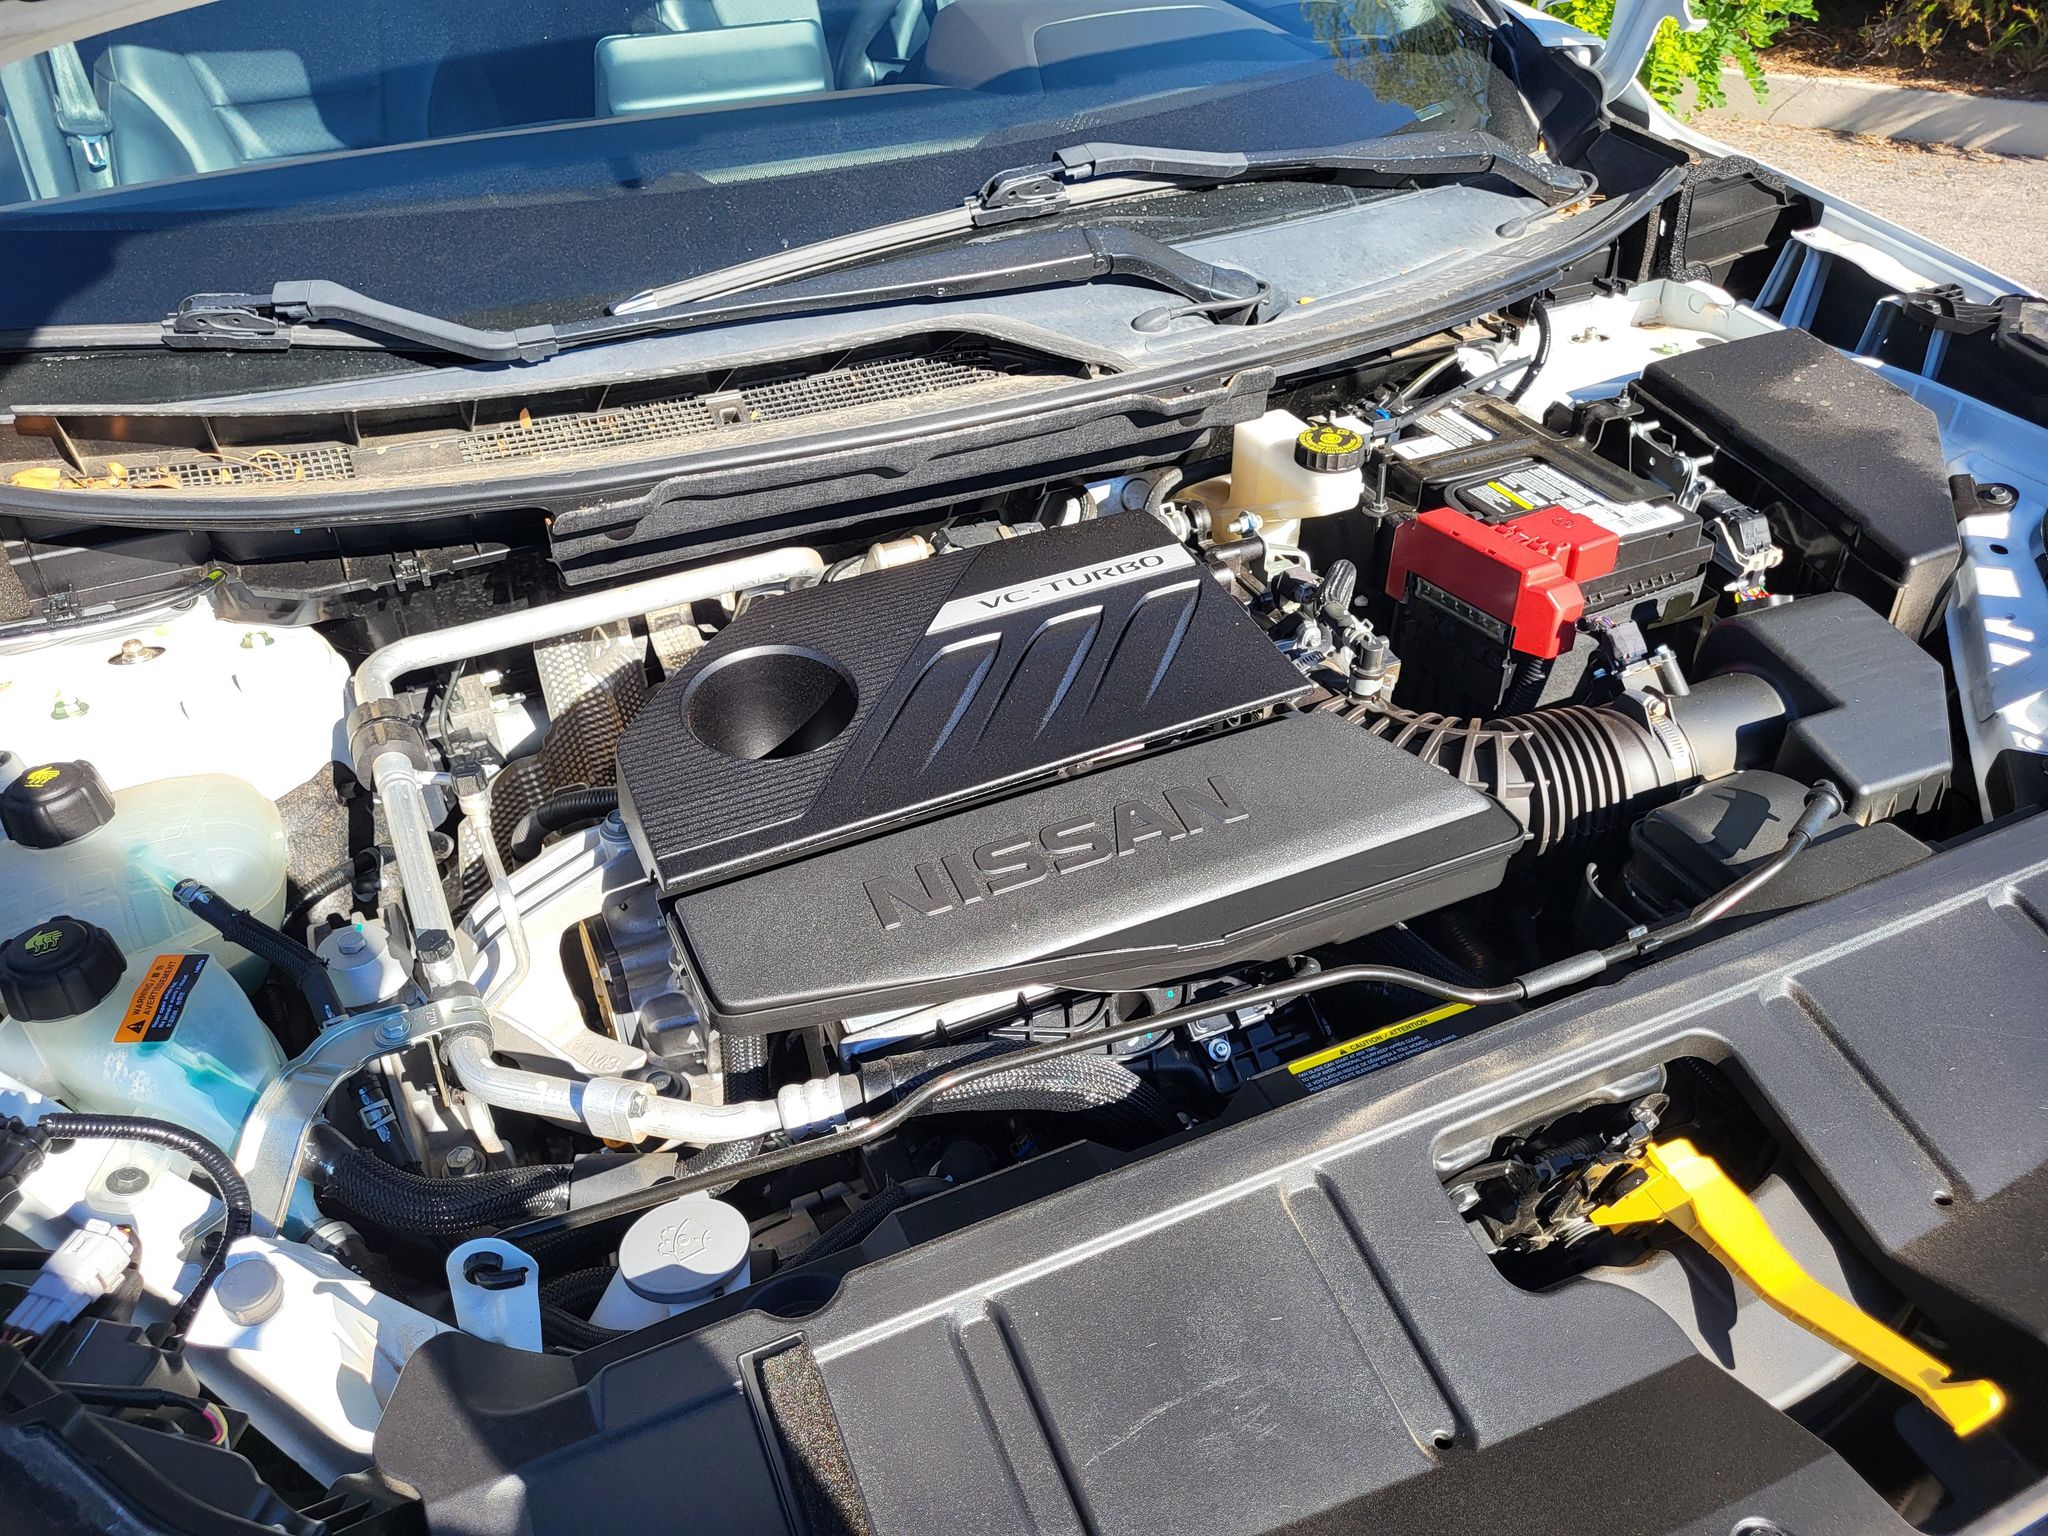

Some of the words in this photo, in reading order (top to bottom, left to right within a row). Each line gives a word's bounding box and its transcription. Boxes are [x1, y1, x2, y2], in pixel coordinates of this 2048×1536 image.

[977, 555, 1165, 609] VC-TURBO
[862, 775, 1250, 930] NISSAN
[132, 981, 154, 1015] WARNING
[143, 961, 176, 1015] AVERTISSEMENT
[1350, 1035, 1383, 1050] CAUTION
[1390, 1018, 1428, 1035] ATTENTION
[1309, 1084, 1324, 1092] POUR
[1340, 1072, 1355, 1080] TOUTE
[1405, 1043, 1433, 1056] APPROCHER
[1310, 1072, 1322, 1080] HELP
[1322, 1066, 1337, 1075] AVOID
[1388, 1041, 1405, 1050] HANDS
[1312, 1071, 1343, 1086] VENTILATEUR
[1397, 1045, 1409, 1053] TOUT
[1323, 1061, 1335, 1069] CAN
[1334, 1056, 1349, 1065] START
